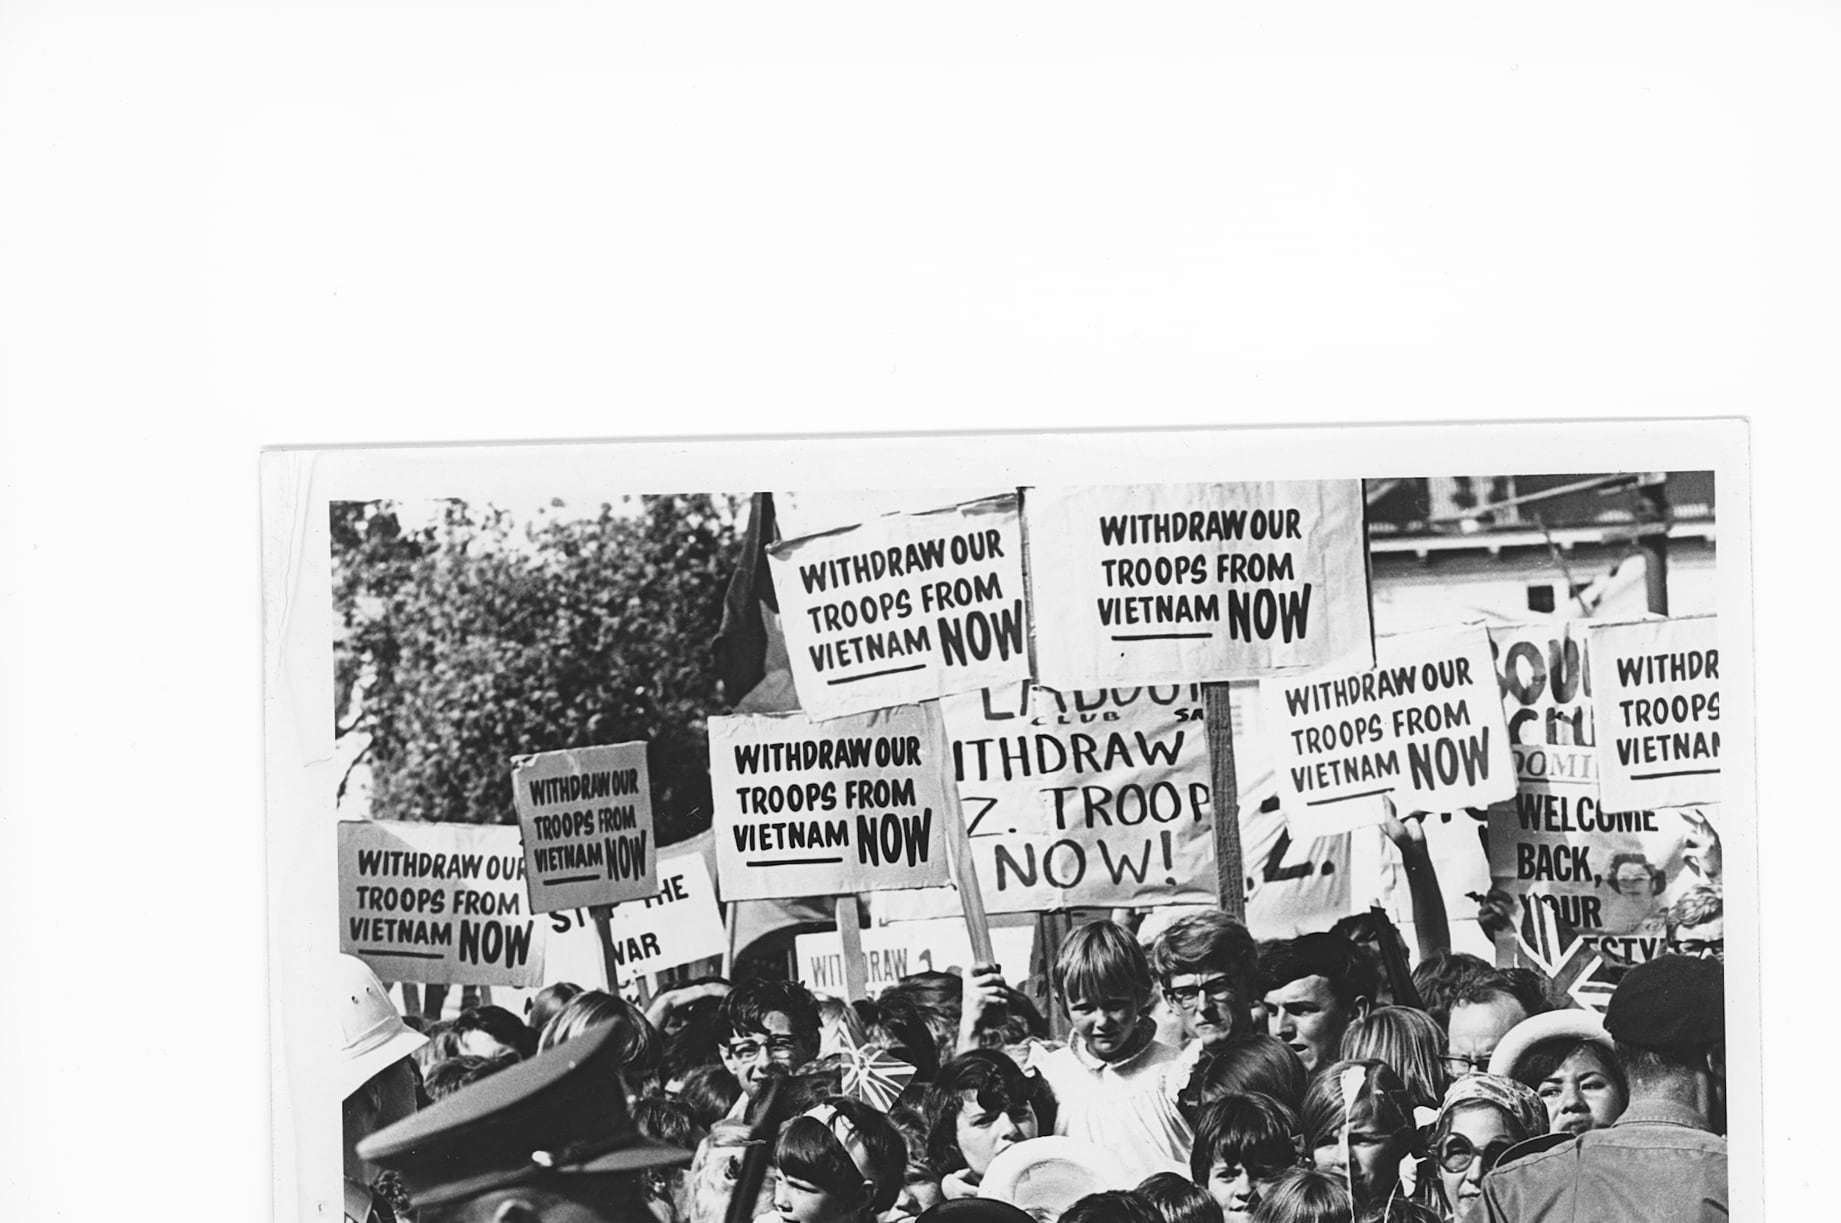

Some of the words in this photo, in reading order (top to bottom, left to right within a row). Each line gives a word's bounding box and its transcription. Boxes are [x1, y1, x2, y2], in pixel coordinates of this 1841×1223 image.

[1100, 510, 1247, 546] WITHDRAW
[1250, 508, 1302, 540] OUR
[800, 538, 945, 594] WITHDRAW
[950, 529, 1004, 565] OUR
[1101, 554, 1207, 588] TROOPS
[1217, 552, 1294, 583] FROM
[807, 589, 912, 633] TROOPS
[921, 572, 1003, 613] FROM
[1097, 594, 1220, 626] VIETNAM
[1228, 583, 1312, 644] NOW
[809, 626, 931, 672] VIETNAM
[937, 599, 1022, 667] NOW
[1285, 666, 1417, 717] WITHDRAW
[1422, 657, 1473, 691] OUR
[1291, 713, 1383, 755] TROOPS
[1392, 699, 1470, 737] FROM
[734, 737, 872, 775] WITHDRAW
[875, 736, 922, 767] OUR
[1291, 750, 1400, 792] VIETNAM
[1407, 726, 1489, 791] NOW
[529, 774, 611, 806] WITHDRAW
[612, 768, 639, 797] OUR
[736, 782, 837, 814] TROOPS
[846, 778, 916, 809] FROM
[534, 810, 594, 841] TROOPS
[599, 804, 636, 833] FROM
[733, 820, 849, 852] VIETNAM
[856, 808, 932, 867] NOW
[358, 849, 483, 882] WITHDRAW
[534, 842, 602, 874] VIETNAM
[605, 830, 647, 882] NOW
[994, 830, 1176, 891] NOW!
[1517, 842, 1601, 888] BACK,
[356, 885, 445, 914] TROOPS
[453, 888, 520, 917] FROM
[350, 917, 451, 946] VIETNAM
[459, 920, 534, 969] NOW
